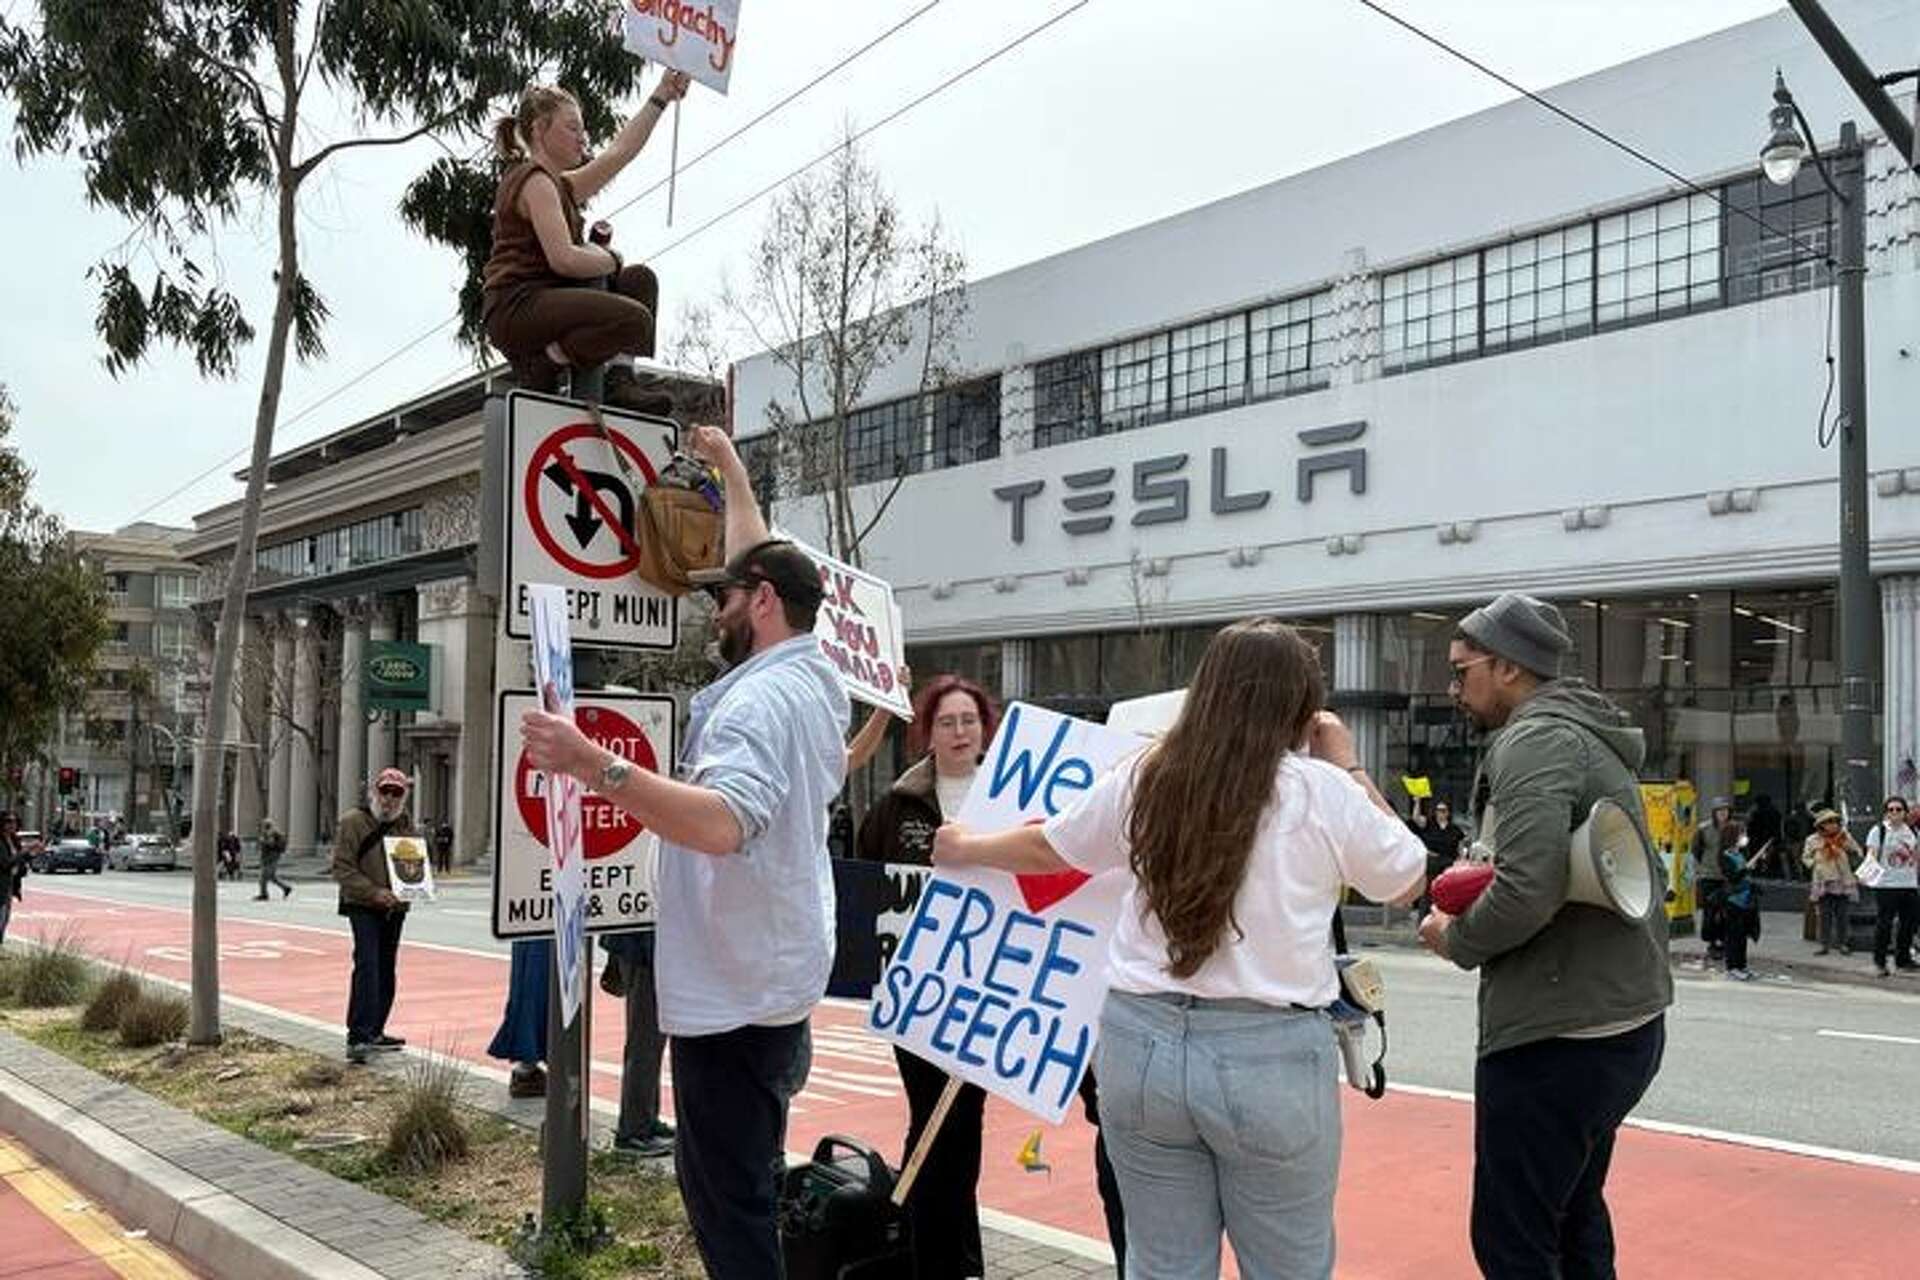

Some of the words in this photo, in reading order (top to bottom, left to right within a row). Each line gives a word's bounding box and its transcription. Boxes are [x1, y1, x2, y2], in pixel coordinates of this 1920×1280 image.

[992, 420, 1368, 545] TESLA
[518, 584, 600, 620] EEPT
[613, 594, 668, 627] MUNI
[988, 706, 1095, 817] We
[583, 806, 629, 828] TER
[508, 897, 553, 923] MU
[540, 865, 636, 892] EEPT
[899, 878, 1095, 1010] FREE
[870, 965, 1090, 1109] SPEECH
